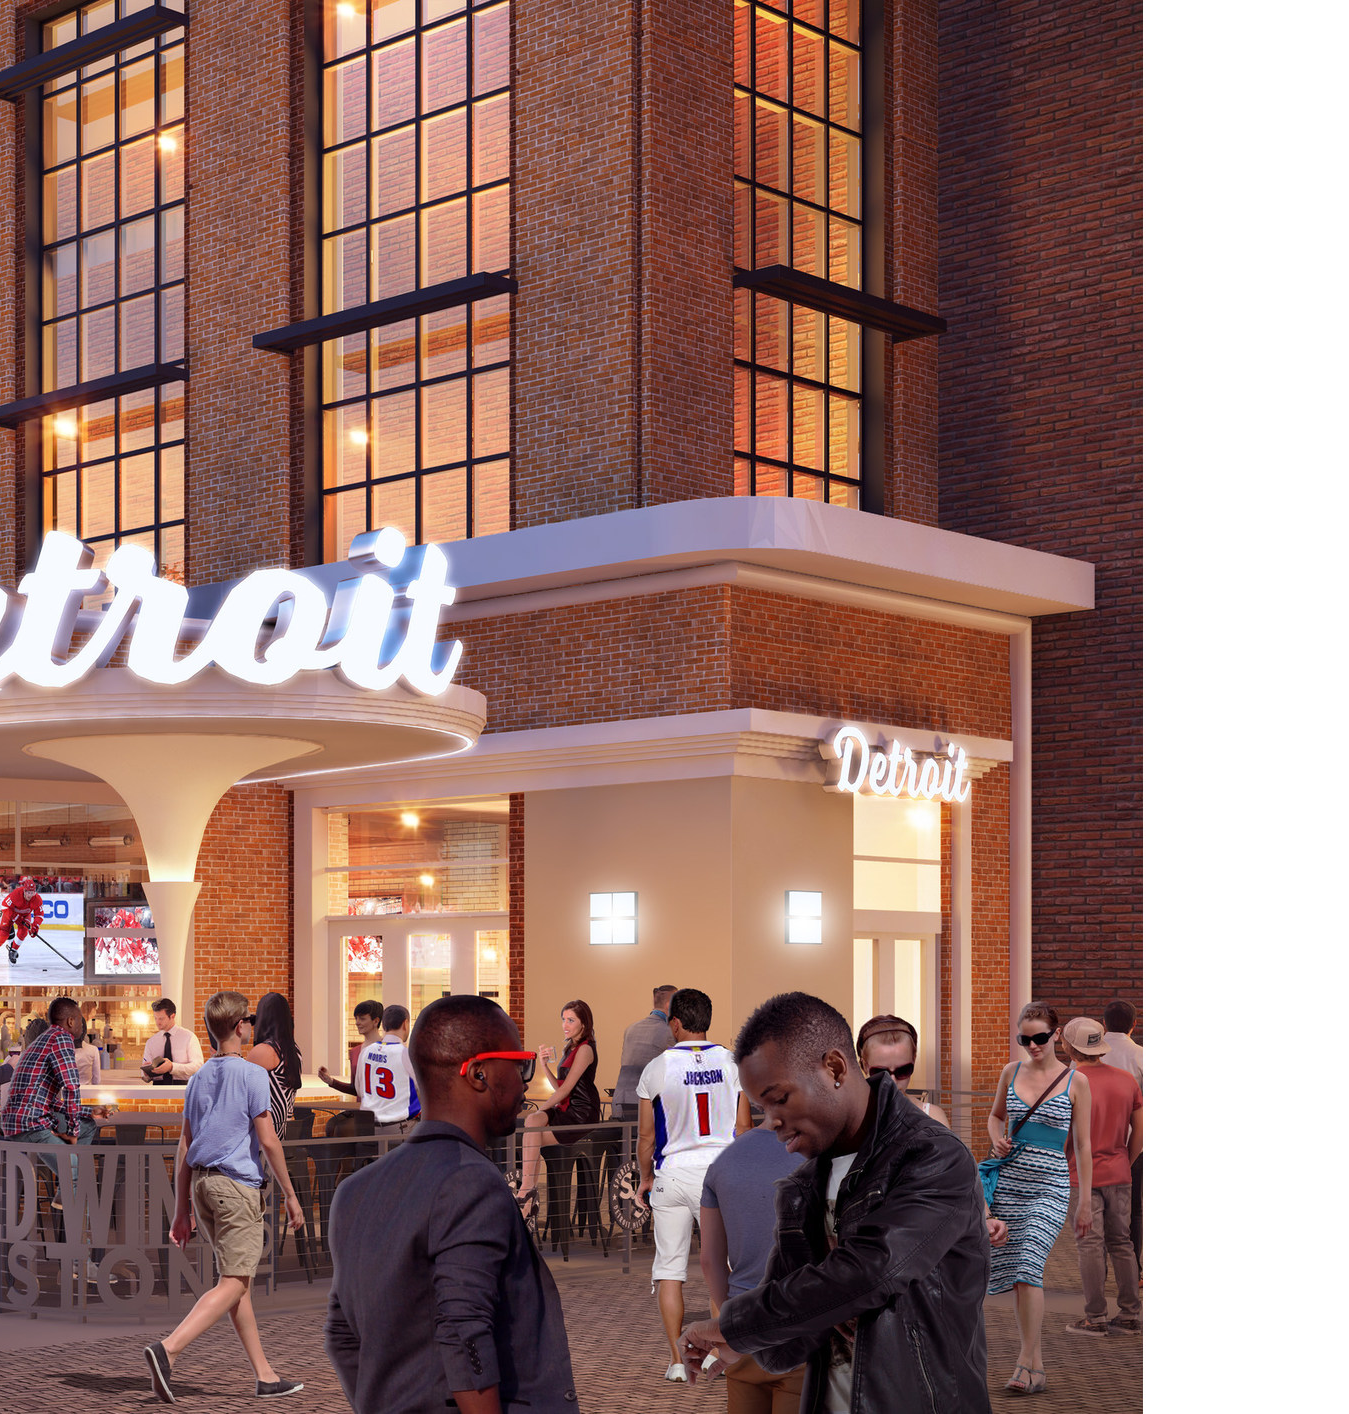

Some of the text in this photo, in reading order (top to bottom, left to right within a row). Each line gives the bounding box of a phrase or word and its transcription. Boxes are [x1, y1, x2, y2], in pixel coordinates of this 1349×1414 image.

[833, 727, 971, 802] Detroit
[364, 1063, 396, 1100] 13
[684, 1069, 723, 1086] JACKSON
[695, 1092, 711, 1136] 1
[613, 1163, 631, 1189] SPORTS
